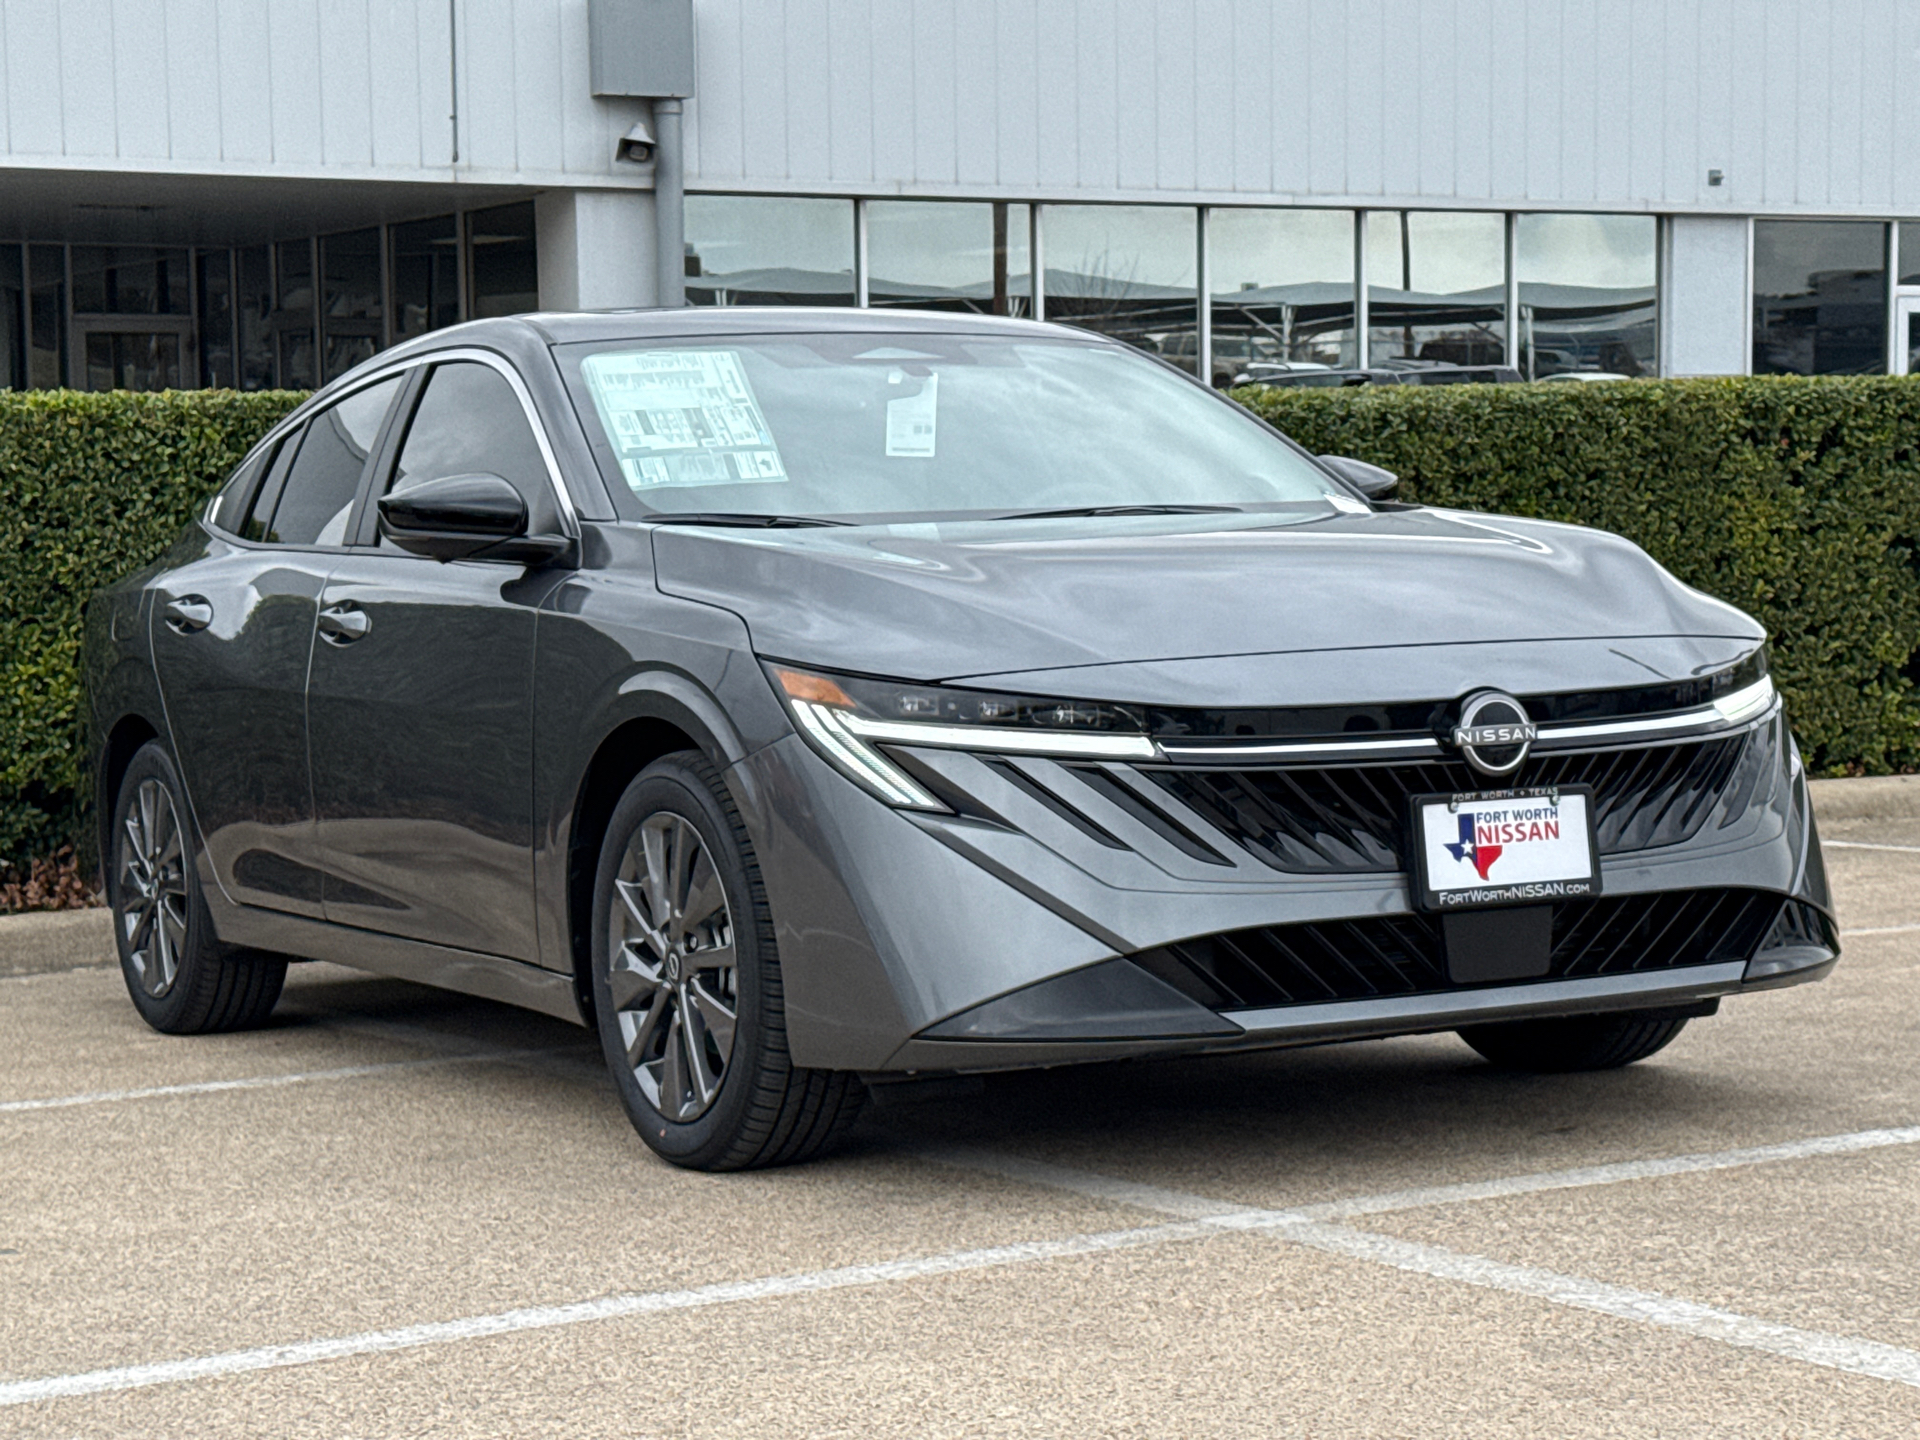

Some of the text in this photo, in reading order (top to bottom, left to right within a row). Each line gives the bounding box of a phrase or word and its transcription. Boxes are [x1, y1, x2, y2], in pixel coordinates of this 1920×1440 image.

[1457, 727, 1536, 743] NISSAN
[1452, 787, 1558, 802] FORT WORTH TEXAS
[1476, 808, 1558, 823] FORT WORTH
[1477, 821, 1559, 844] NISSAN
